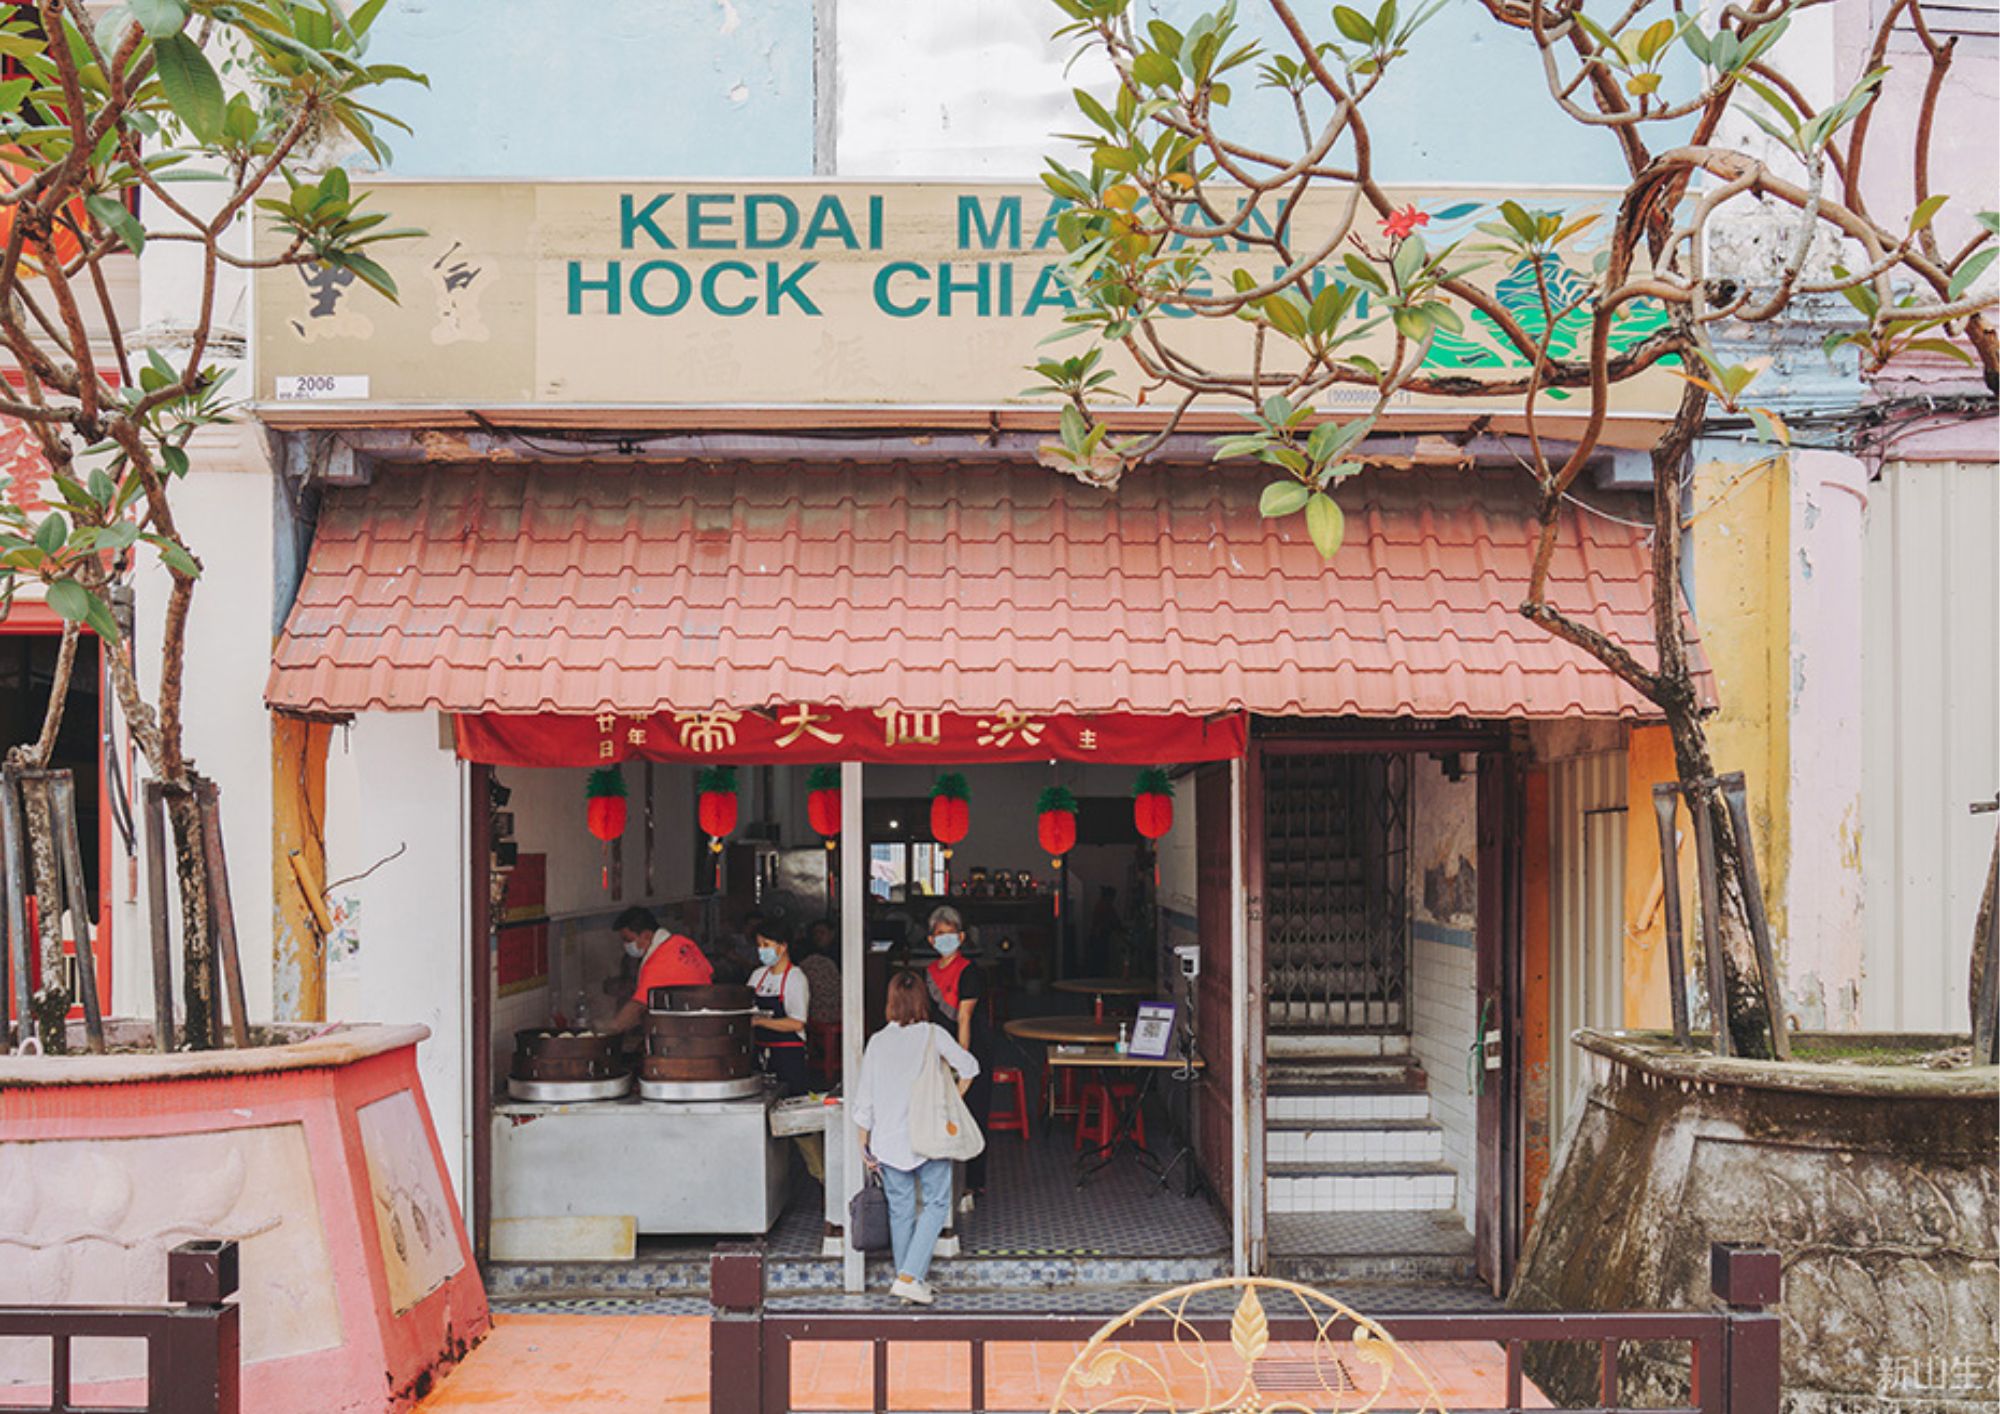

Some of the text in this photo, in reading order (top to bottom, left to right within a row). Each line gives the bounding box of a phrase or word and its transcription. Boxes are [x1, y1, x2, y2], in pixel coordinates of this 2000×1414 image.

[620, 193, 1291, 252] KEDAI MAAN
[567, 260, 823, 316] HOCK
[872, 261, 1213, 318] CHIAG
[297, 375, 335, 391] 2006
